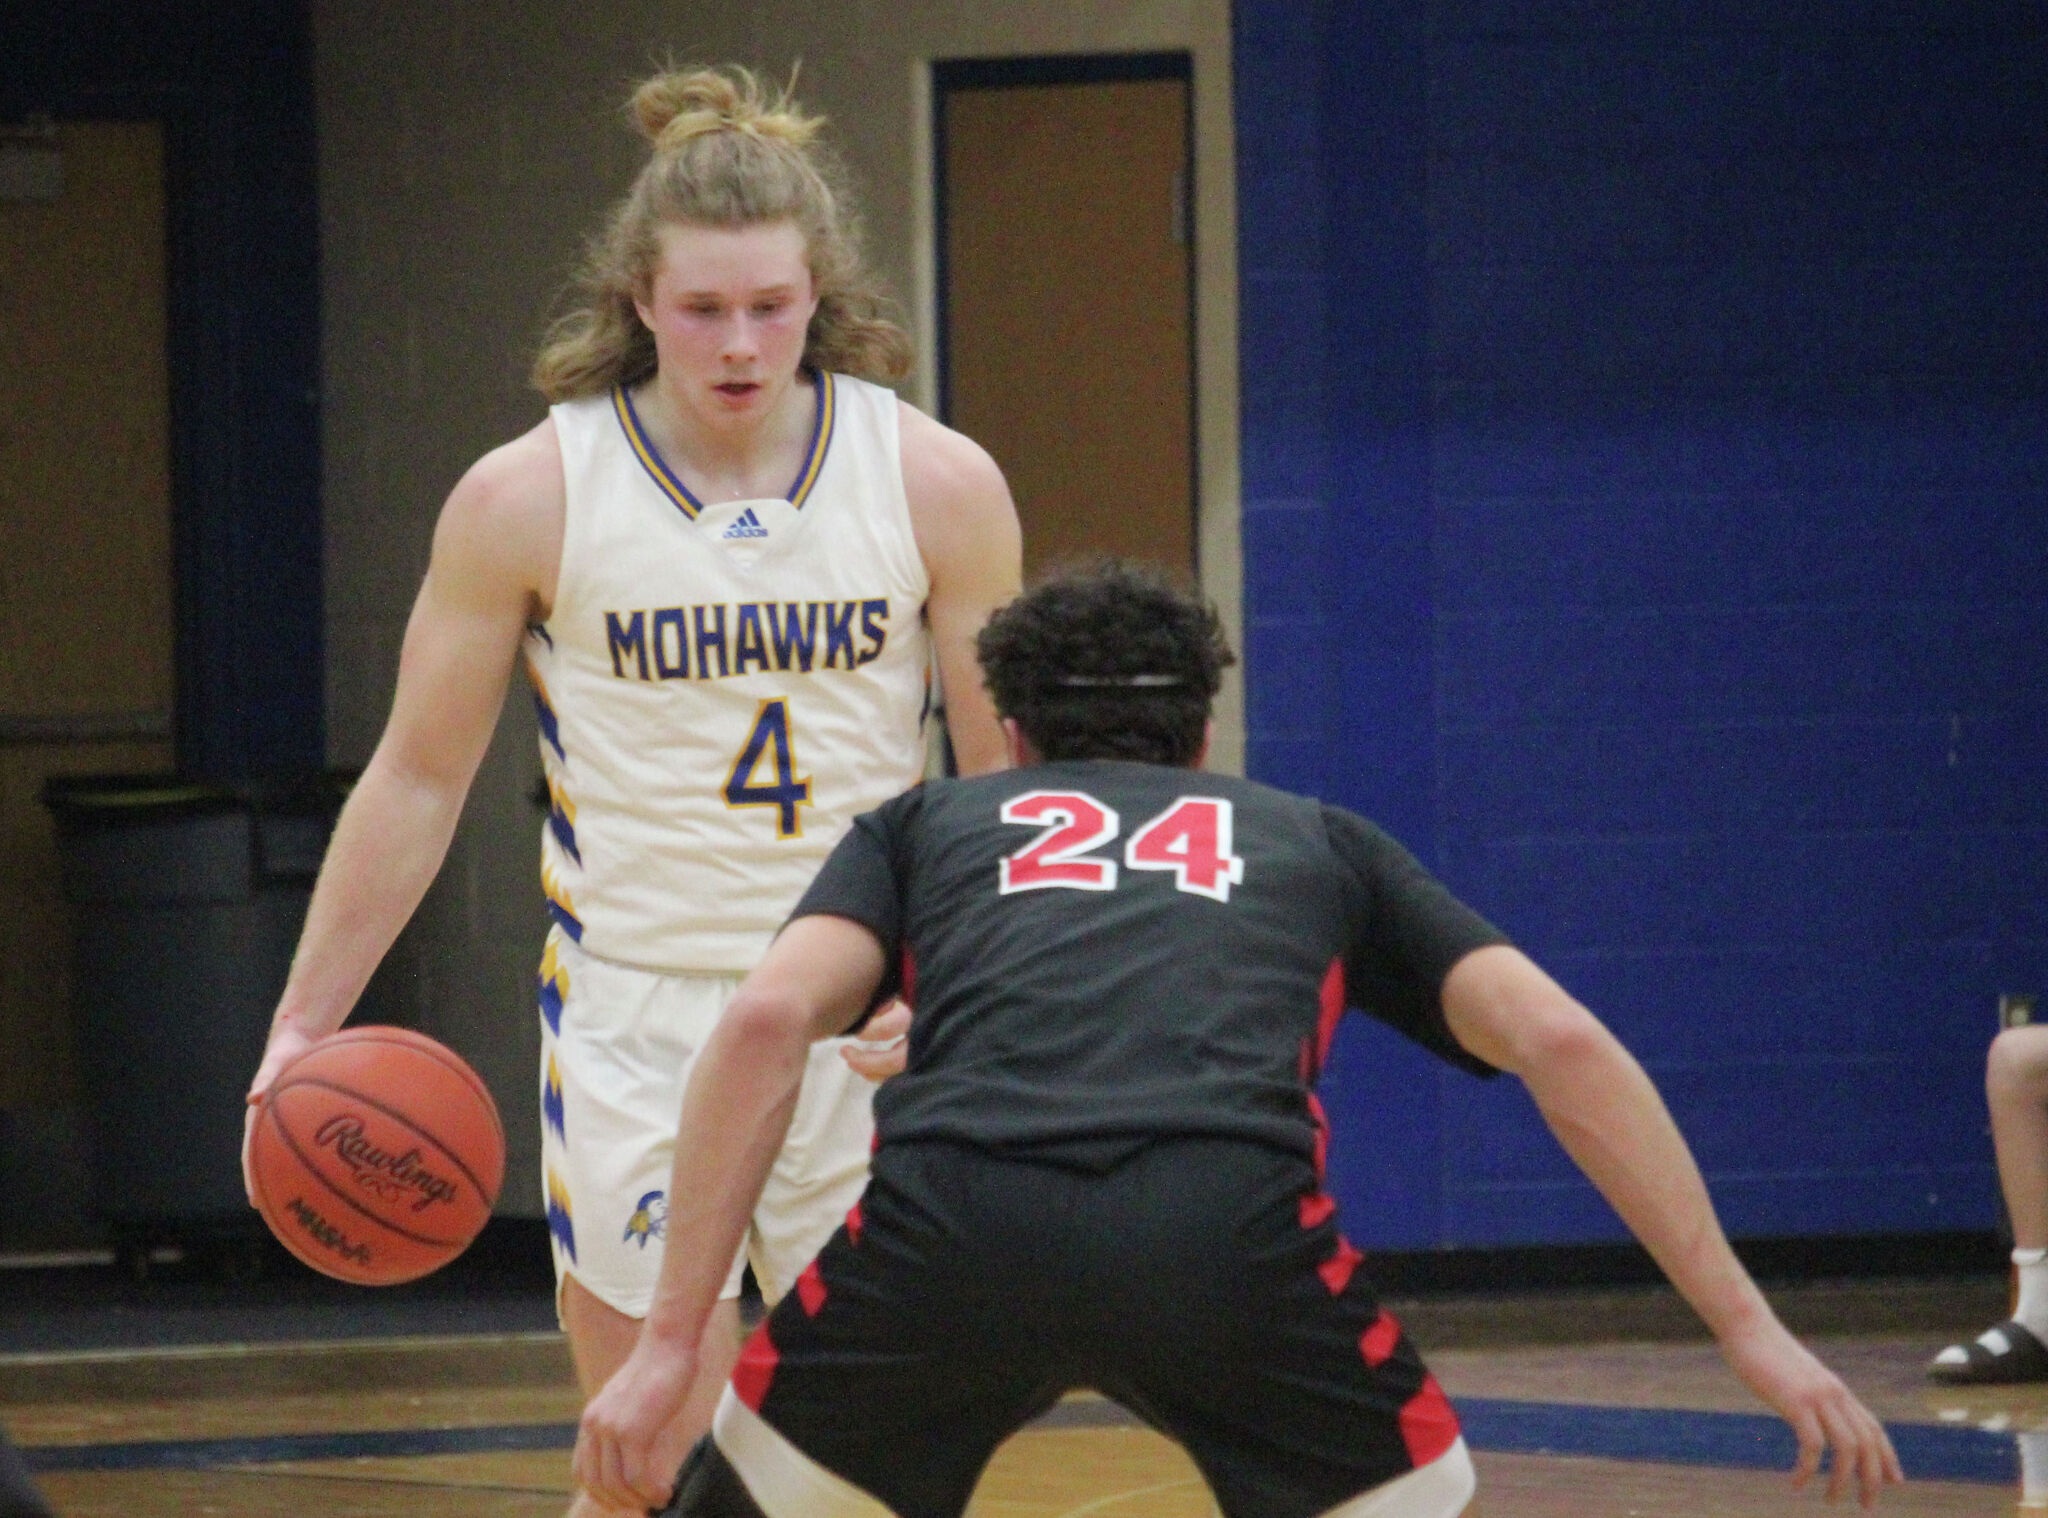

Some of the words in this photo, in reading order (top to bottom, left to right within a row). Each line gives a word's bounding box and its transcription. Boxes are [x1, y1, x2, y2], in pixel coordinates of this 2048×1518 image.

[604, 598, 890, 682] MOHAWKS
[720, 695, 813, 840] 4
[998, 789, 1244, 903] 24
[314, 1114, 457, 1212] Rawlings
